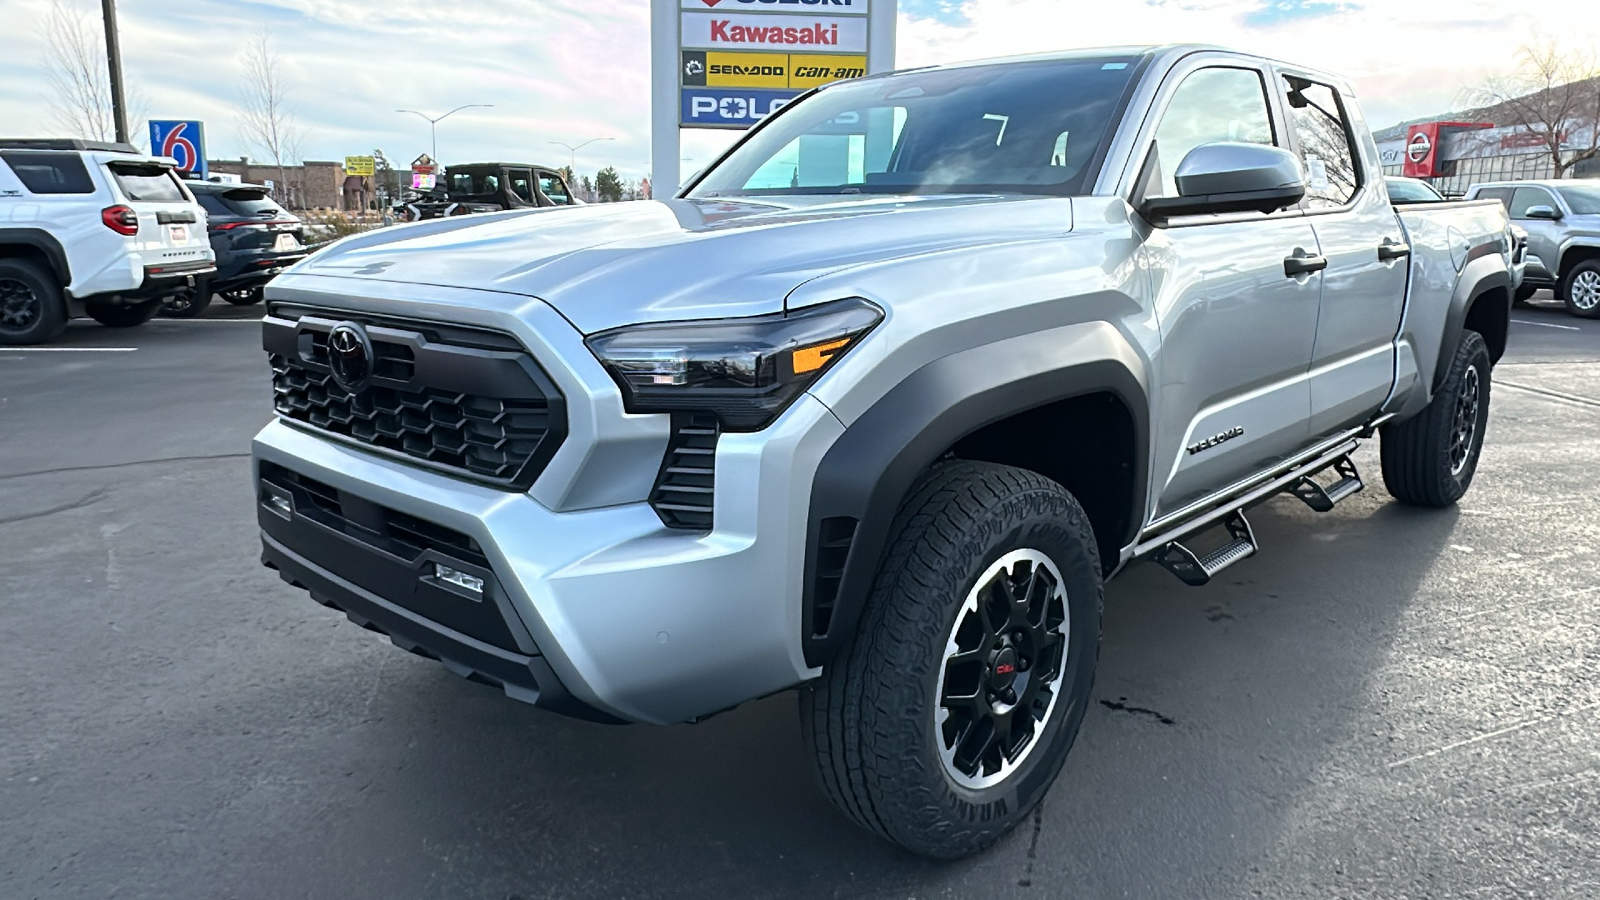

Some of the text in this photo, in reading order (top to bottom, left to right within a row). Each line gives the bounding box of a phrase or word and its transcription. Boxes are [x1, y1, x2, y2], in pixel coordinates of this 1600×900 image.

[711, 20, 838, 45] Kawasaki
[795, 67, 864, 78] can-am
[162, 123, 197, 171] 6
[1187, 426, 1244, 455] TACOMA
